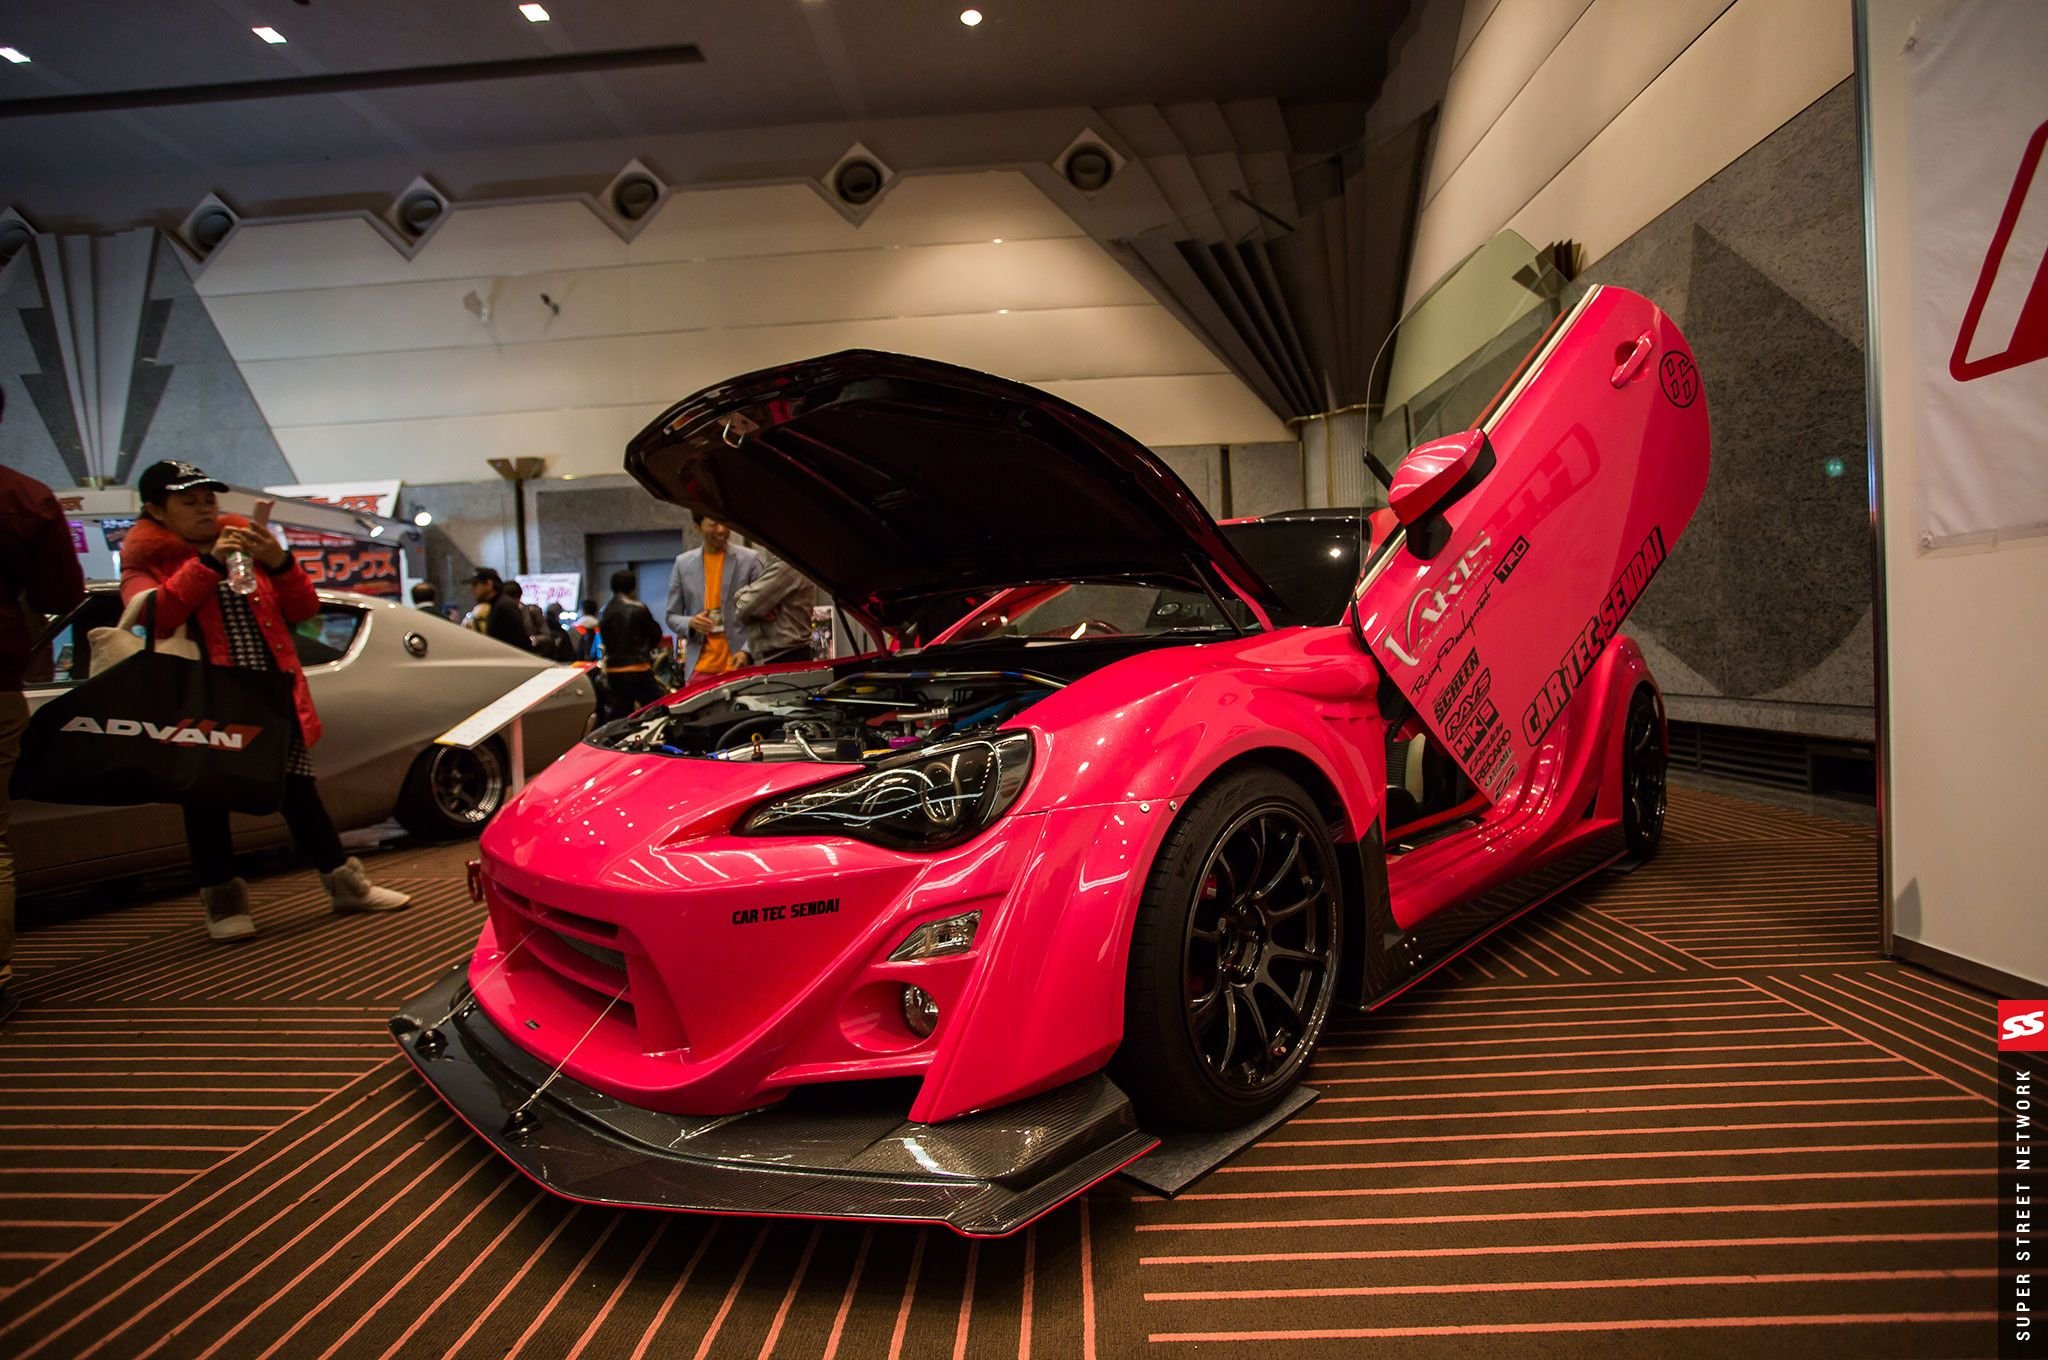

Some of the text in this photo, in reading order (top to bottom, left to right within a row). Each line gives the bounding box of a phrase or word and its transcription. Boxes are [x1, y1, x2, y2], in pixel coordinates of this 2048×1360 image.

[1494, 536, 1530, 583] TRD
[1522, 526, 1667, 747] CAR TEC SENDAI
[1434, 649, 1479, 723] SCREEN
[1445, 667, 1491, 741] RAYS
[59, 715, 243, 749] ADVAN
[1453, 698, 1499, 763] HKS
[1474, 729, 1512, 784] RECARO
[731, 898, 840, 925] CAR TEC SENDAI
